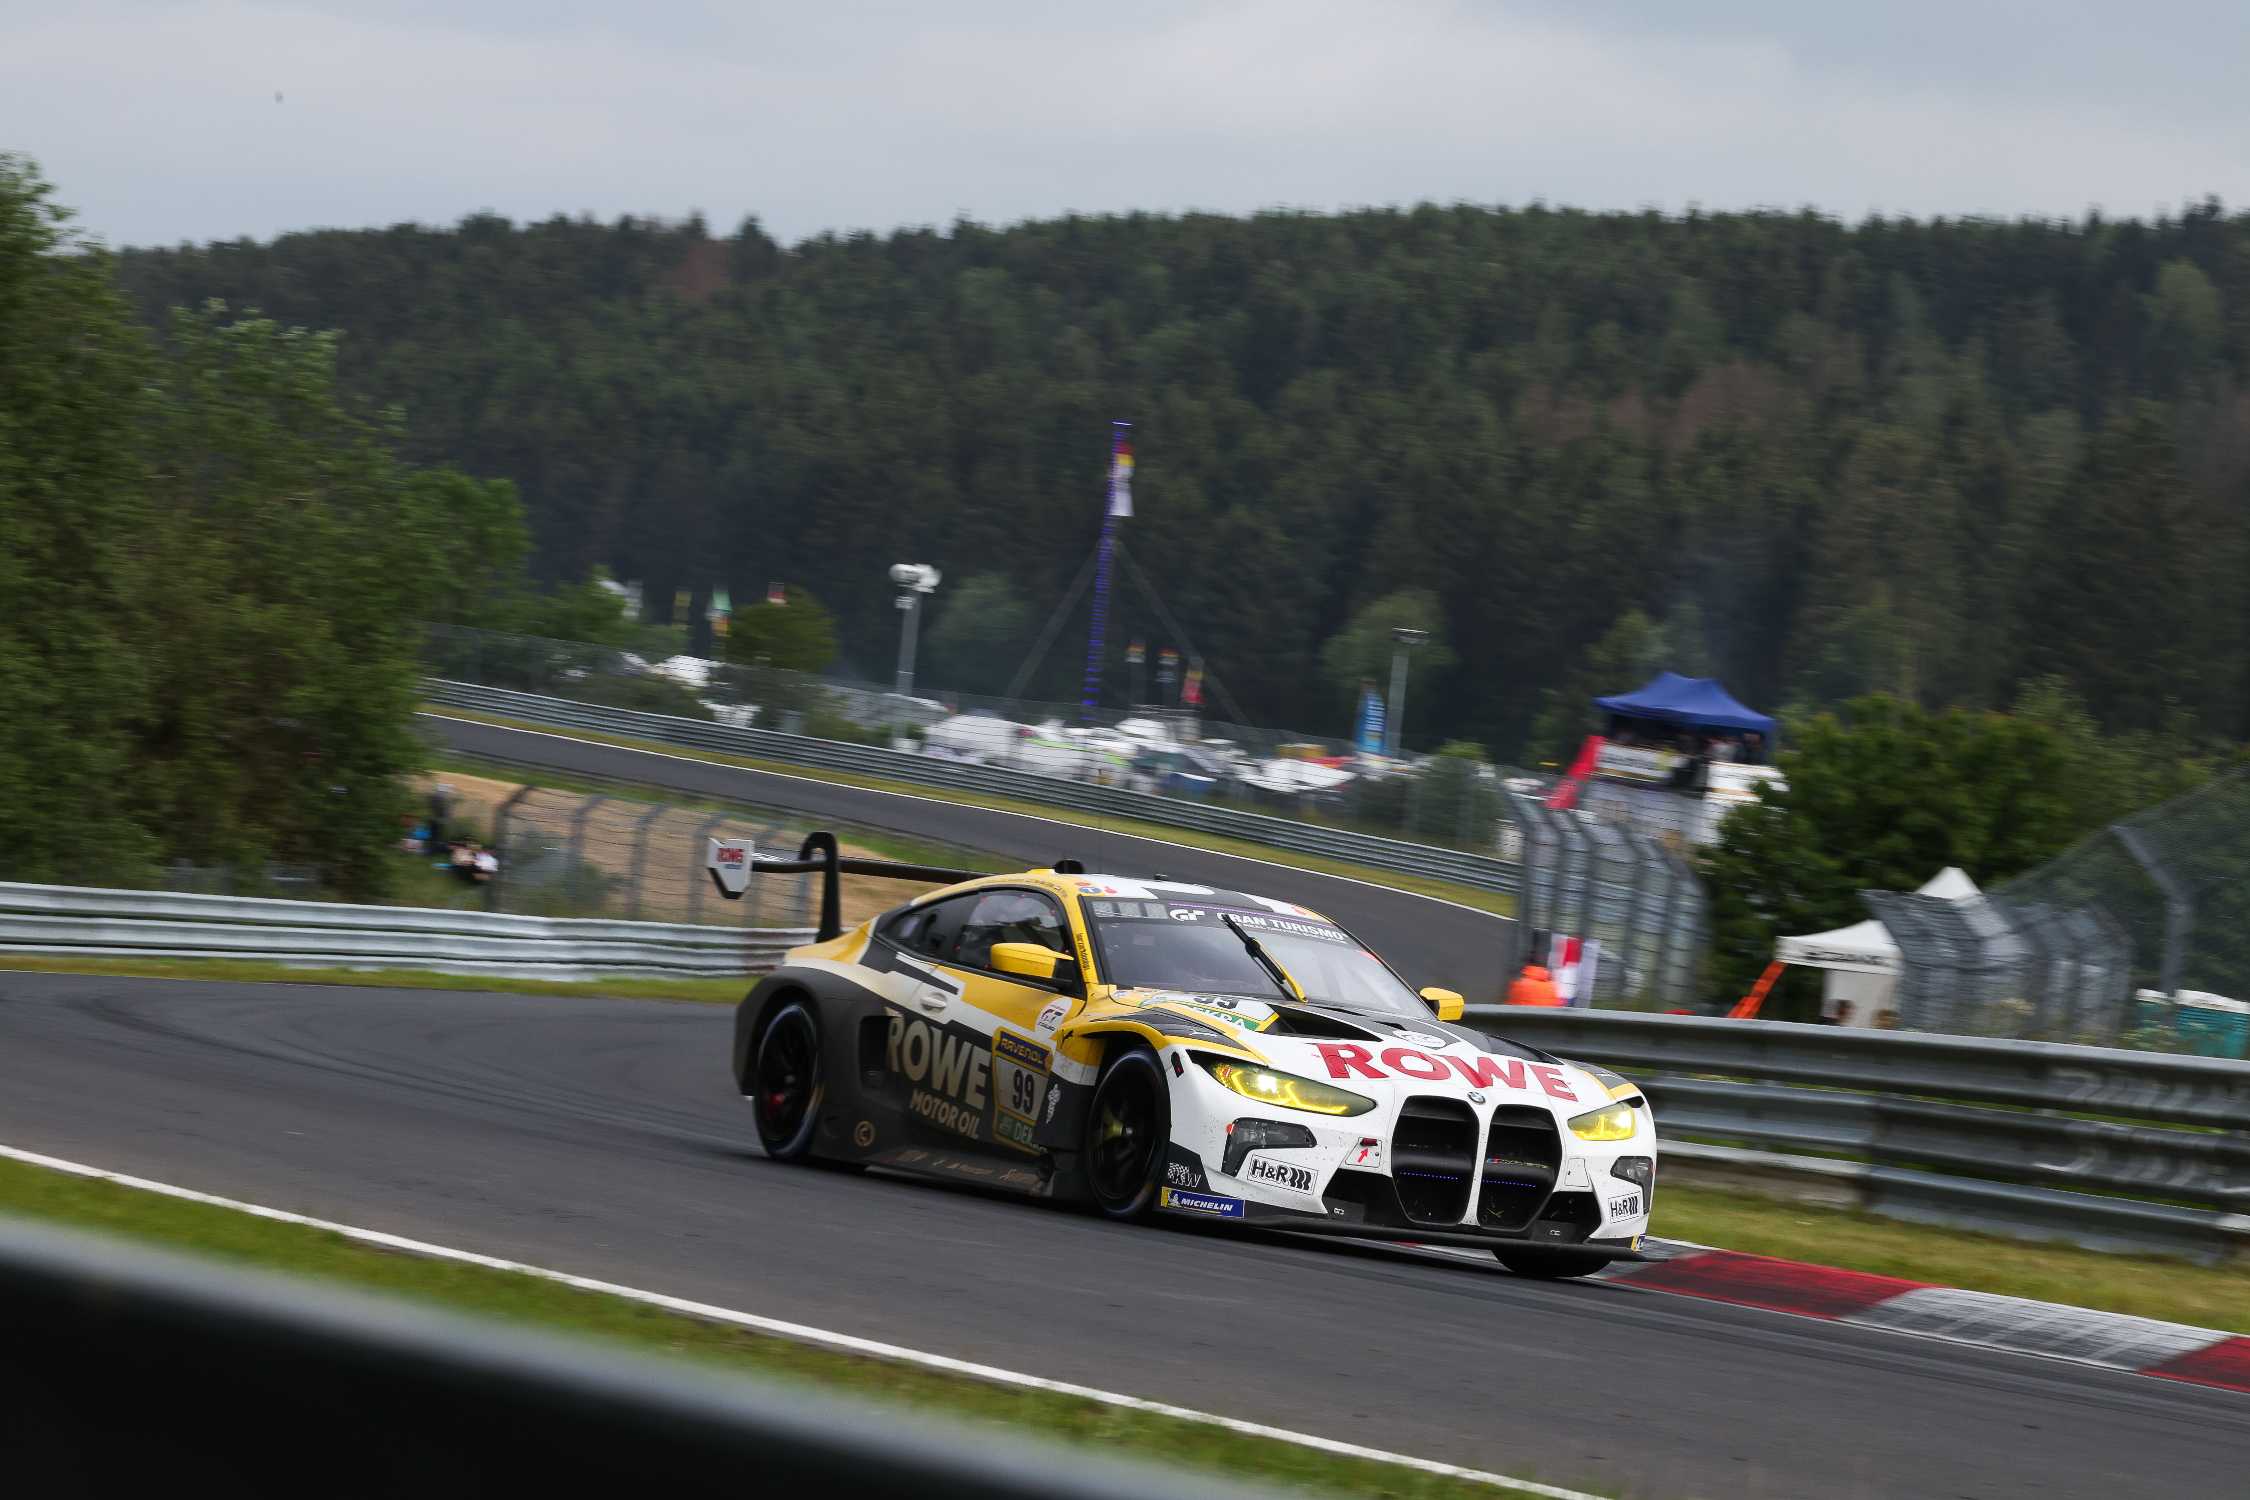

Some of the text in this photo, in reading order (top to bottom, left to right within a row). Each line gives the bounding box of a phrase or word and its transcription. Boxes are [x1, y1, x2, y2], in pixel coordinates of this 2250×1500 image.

[1216, 912, 1266, 927] GRAN
[1270, 918, 1349, 940] TURISMO
[885, 1007, 991, 1110] ROWE
[999, 1037, 1043, 1064] RAVENOL
[1313, 1043, 1579, 1102] ROWE
[1012, 1068, 1035, 1115] 99
[909, 1088, 980, 1139] MOTOR OIL
[1251, 1159, 1289, 1184] H&R
[1181, 1198, 1233, 1213] MICHELIN
[1610, 1199, 1628, 1217] H&R
